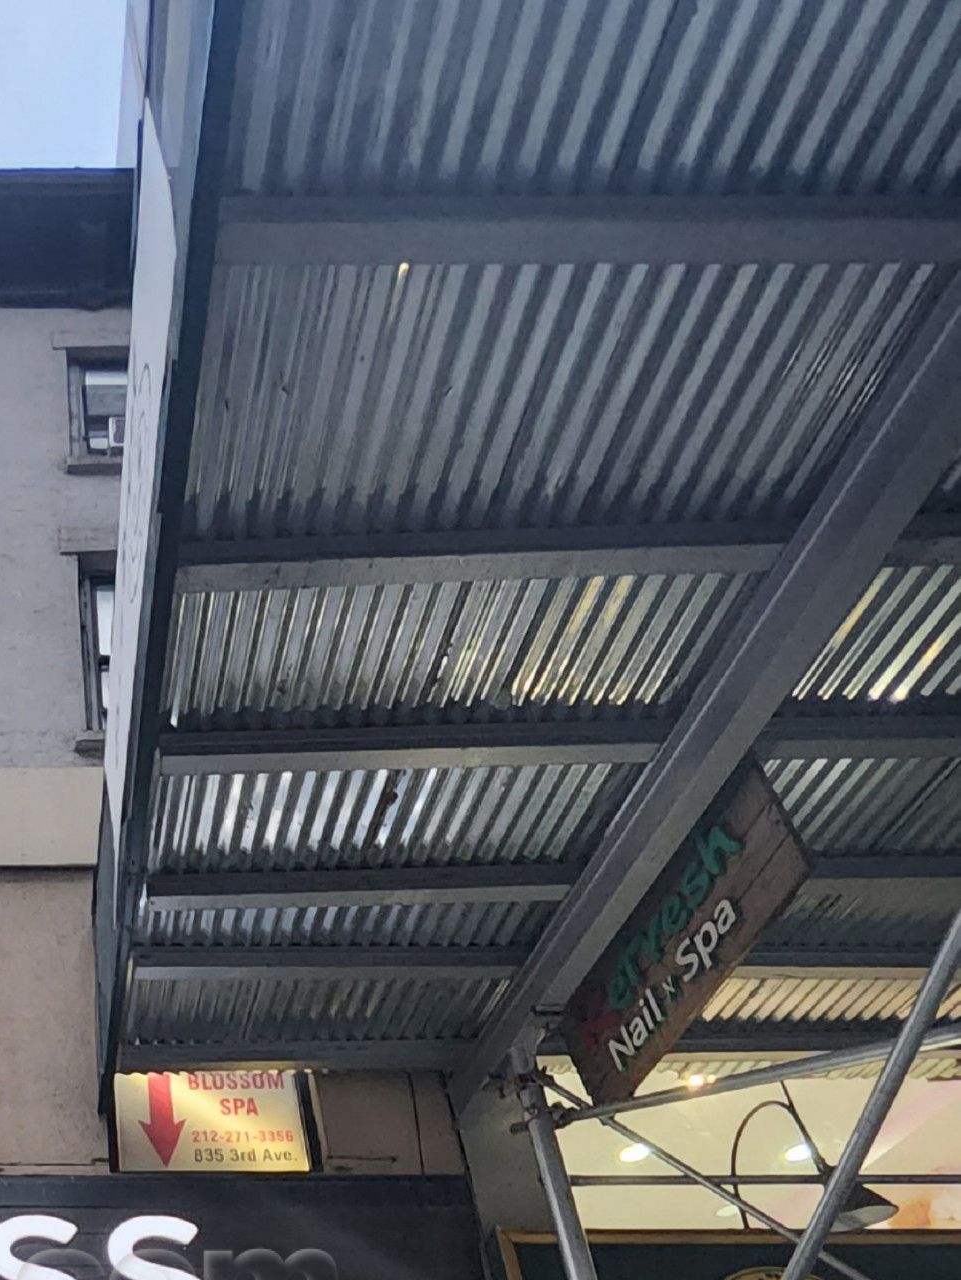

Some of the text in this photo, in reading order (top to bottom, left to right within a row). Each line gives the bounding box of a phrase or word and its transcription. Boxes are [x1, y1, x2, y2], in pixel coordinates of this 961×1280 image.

[607, 988, 663, 1072] Nail
[675, 899, 736, 982] Spa
[188, 1072, 284, 1090] BLOSSOM
[220, 1098, 259, 1117] SPA
[192, 1130, 295, 1143] 212-271-3356
[194, 1148, 299, 1162] 835 3rd Ave.
